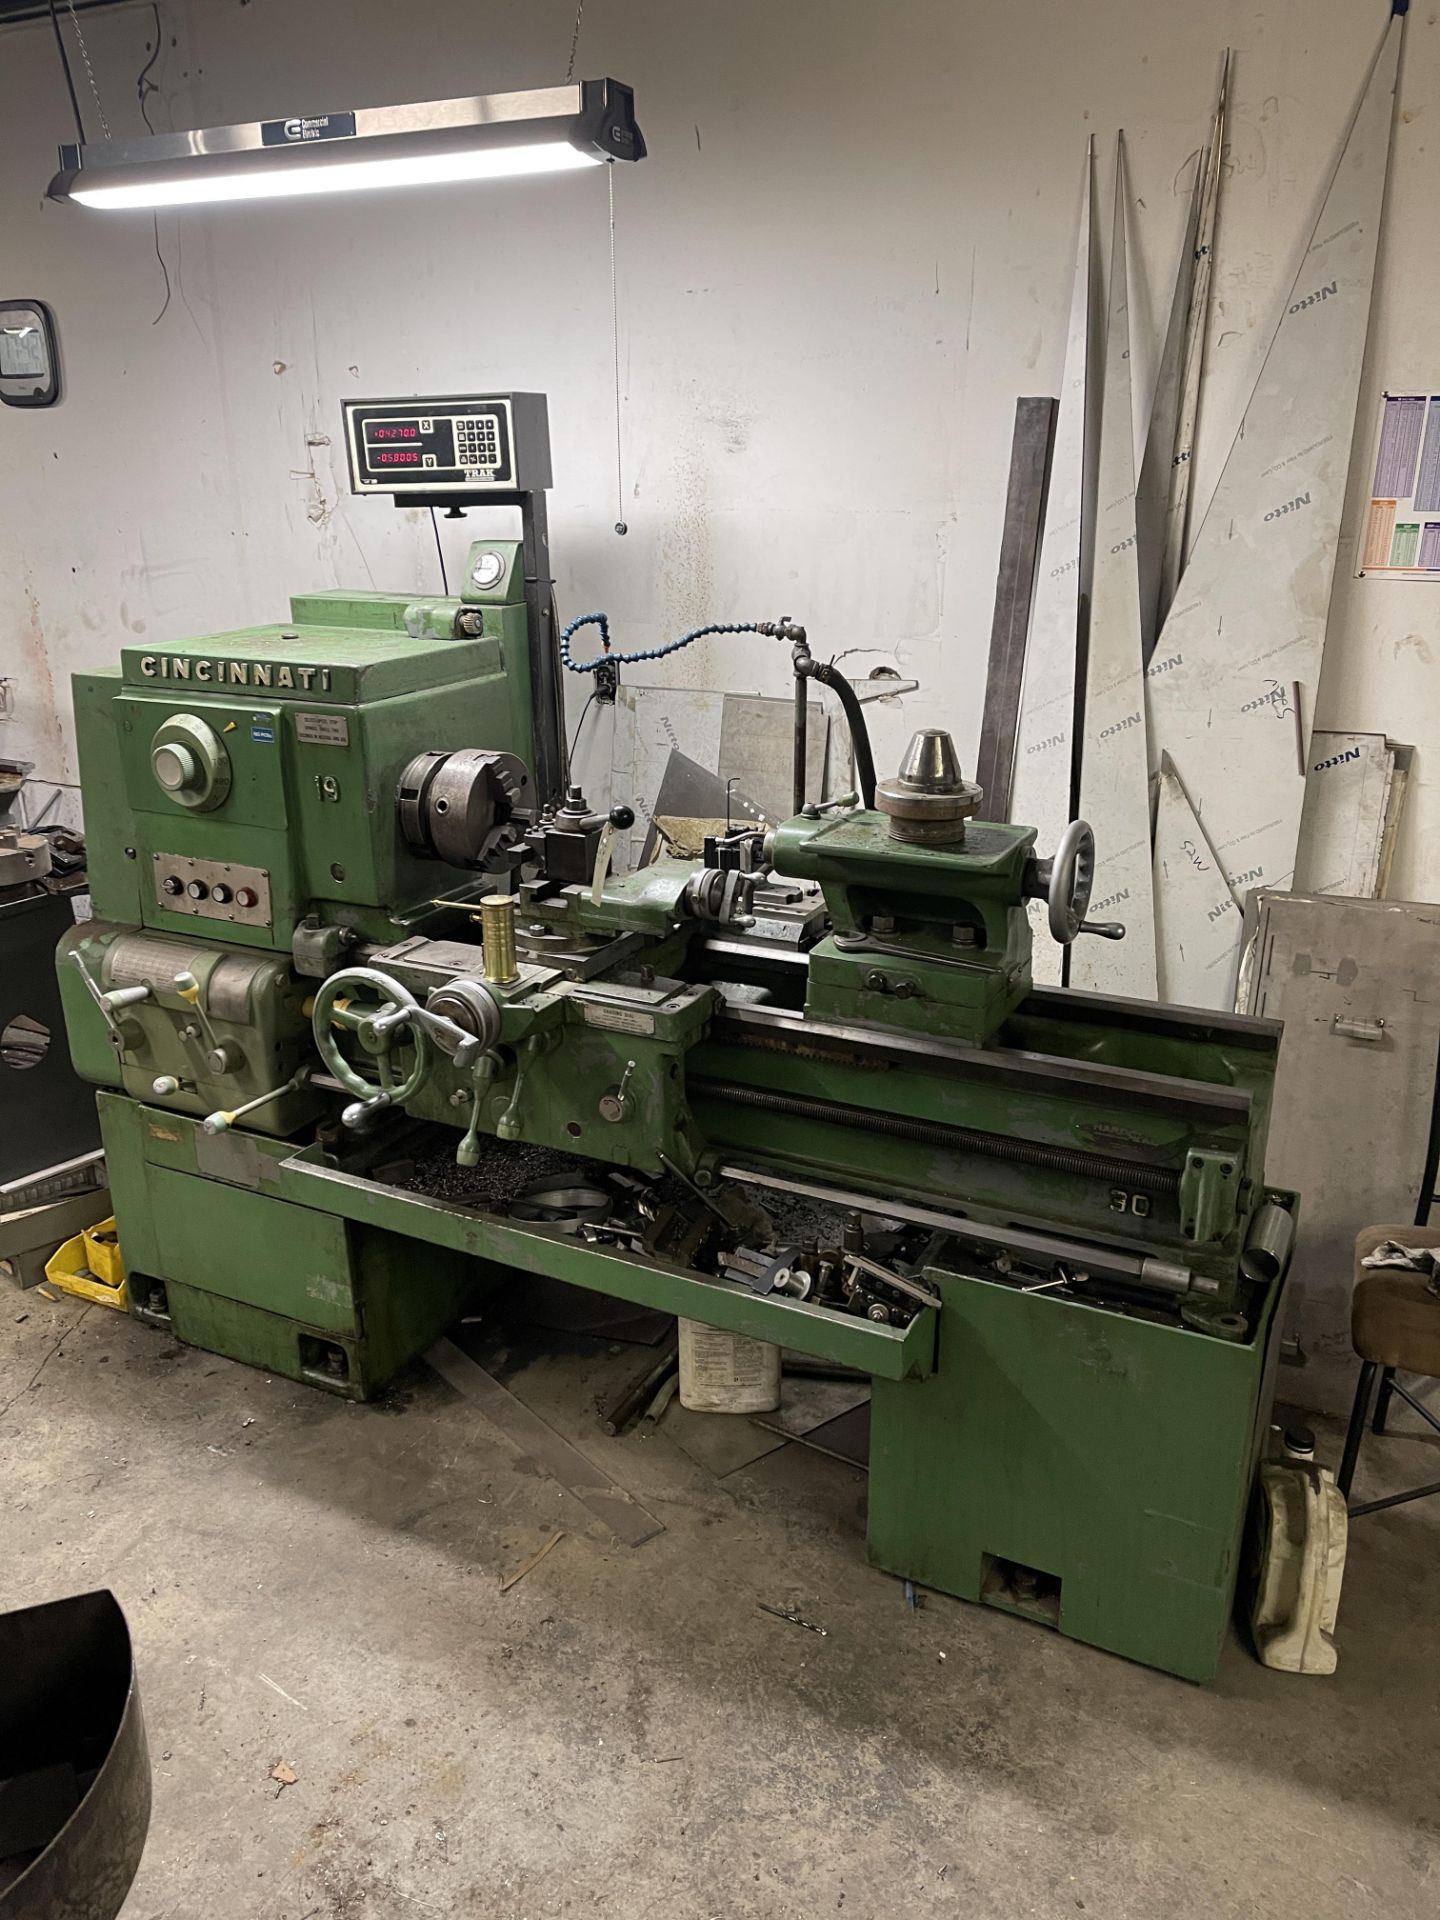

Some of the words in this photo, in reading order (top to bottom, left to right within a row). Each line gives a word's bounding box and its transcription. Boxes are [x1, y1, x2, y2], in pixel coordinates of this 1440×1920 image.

[1289, 281, 1338, 314] Nitto
[464, 468, 496, 478] TRAK
[1263, 492, 1312, 522] Nitto
[1050, 559, 1077, 577] itto
[140, 655, 331, 691] CINCINNATI
[1147, 653, 1183, 677] Nitt
[1241, 686, 1287, 713] Nitto
[1100, 712, 1142, 739] Nitto
[1027, 732, 1065, 754] Nitto
[1314, 747, 1361, 772] Nitto
[314, 775, 337, 801] 19
[1229, 866, 1263, 888] Nitt
[1089, 888, 1130, 913] Nitto
[1110, 1190, 1150, 1217] 30
